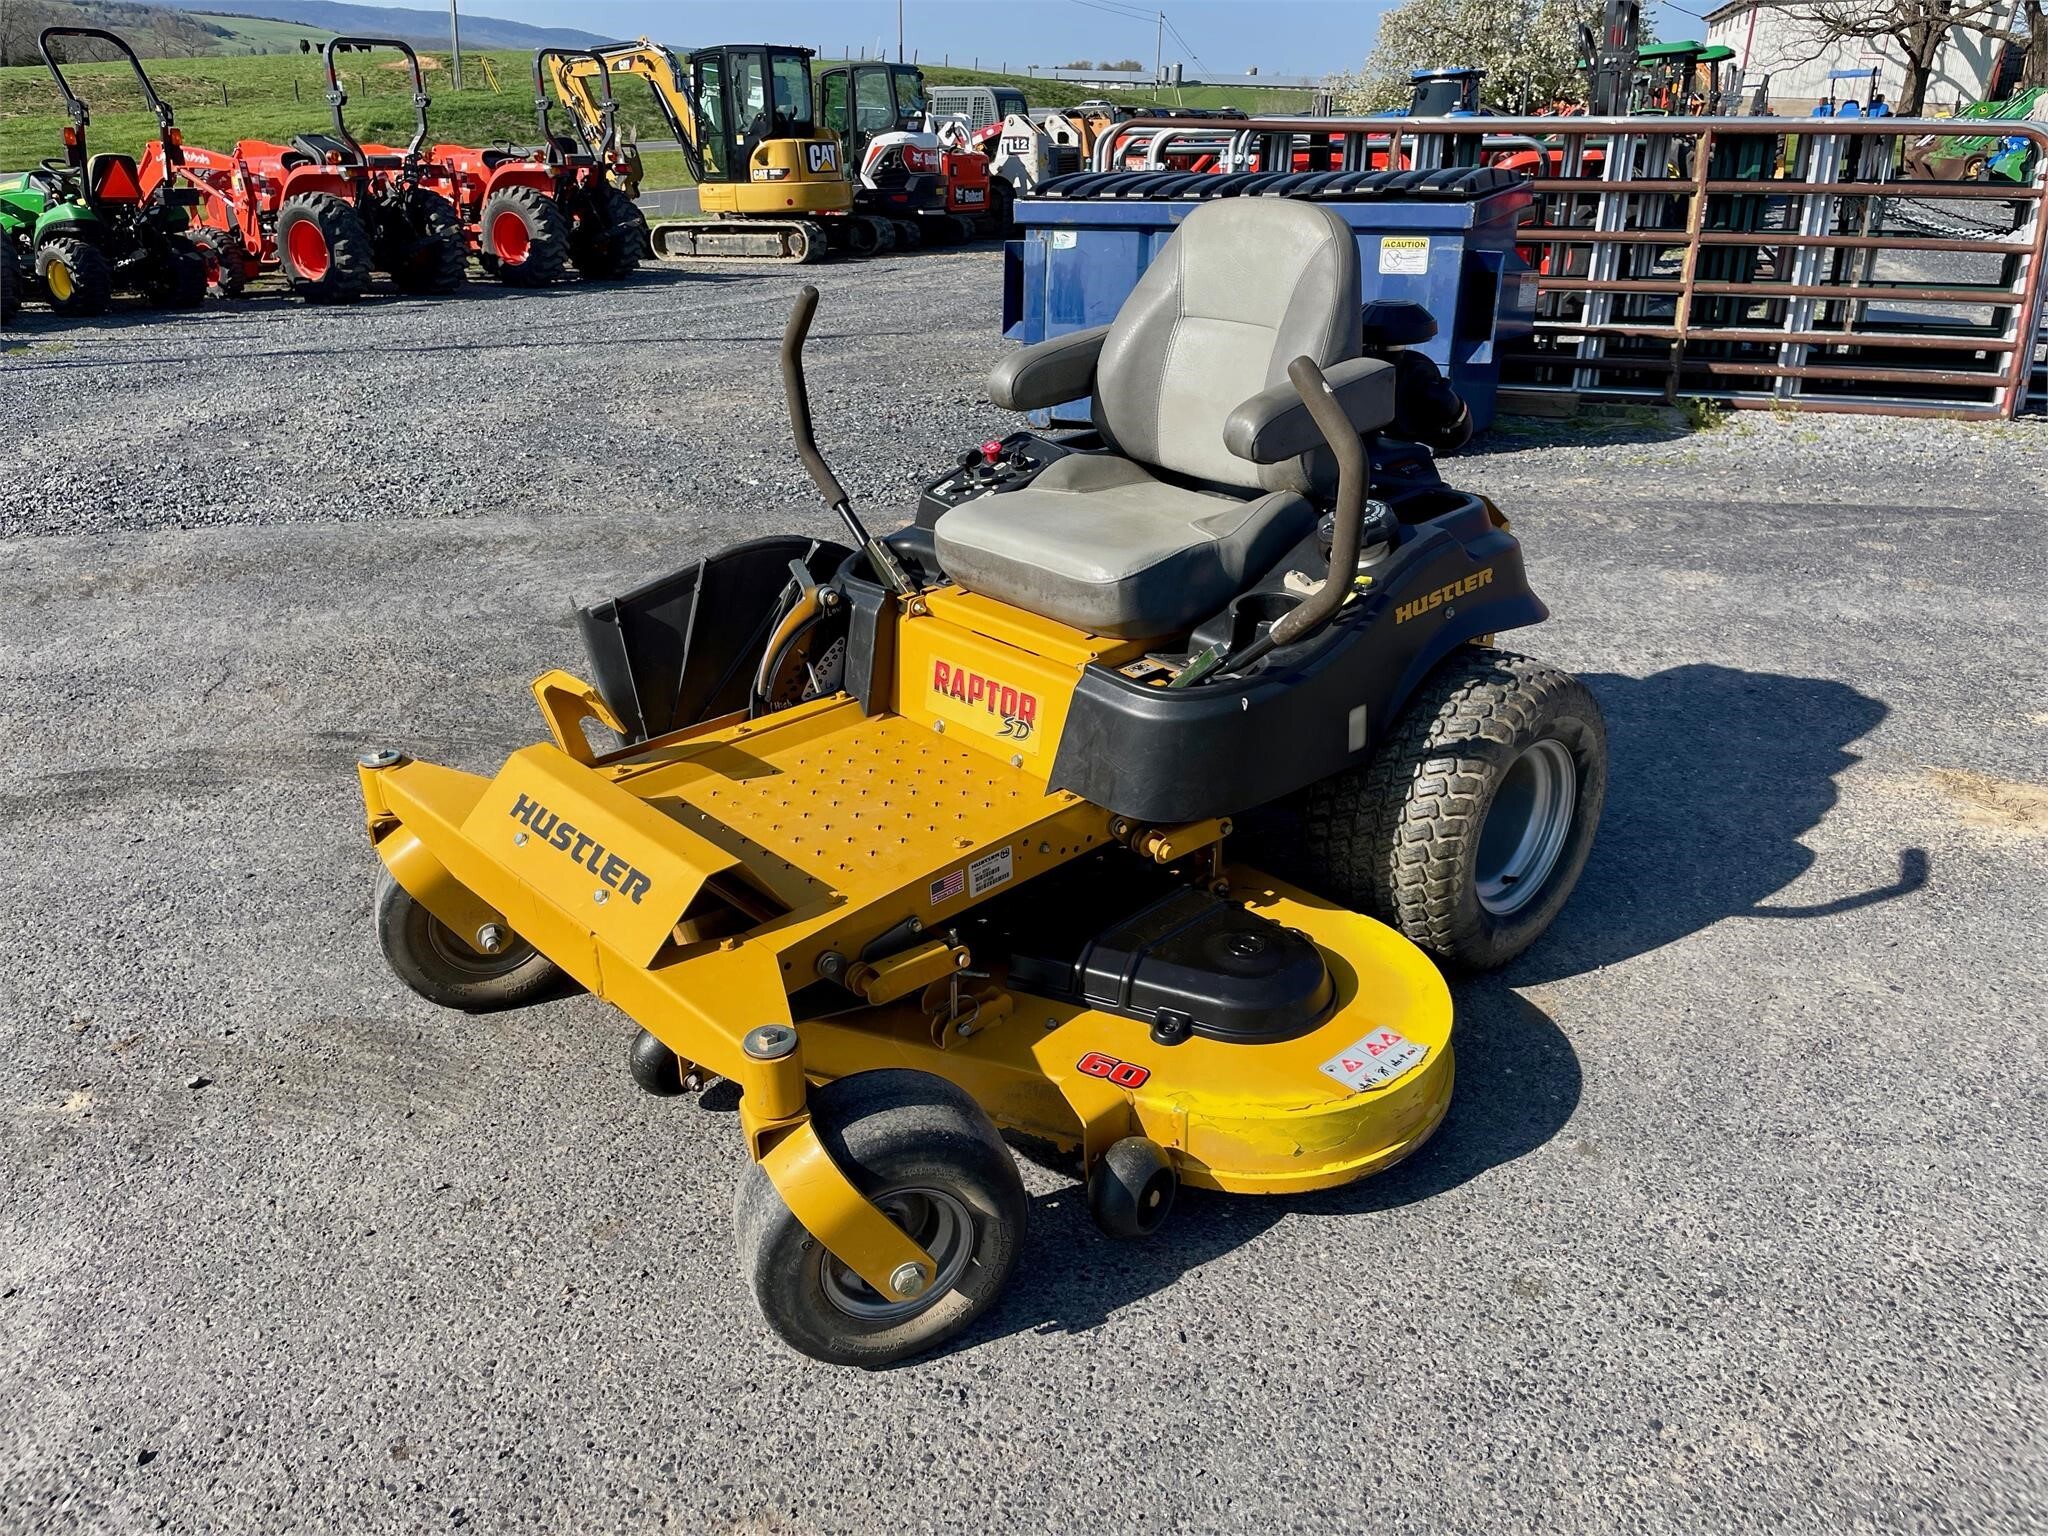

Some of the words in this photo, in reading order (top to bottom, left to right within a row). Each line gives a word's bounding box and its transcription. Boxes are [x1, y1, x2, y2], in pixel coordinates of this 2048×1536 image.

[809, 144, 836, 172] CAT
[1395, 567, 1494, 625] HUSTLER
[933, 660, 1037, 732] RAPTOR
[996, 716, 1032, 741] SD
[509, 793, 652, 905] HUSTLER
[1076, 1052, 1152, 1090] 60
